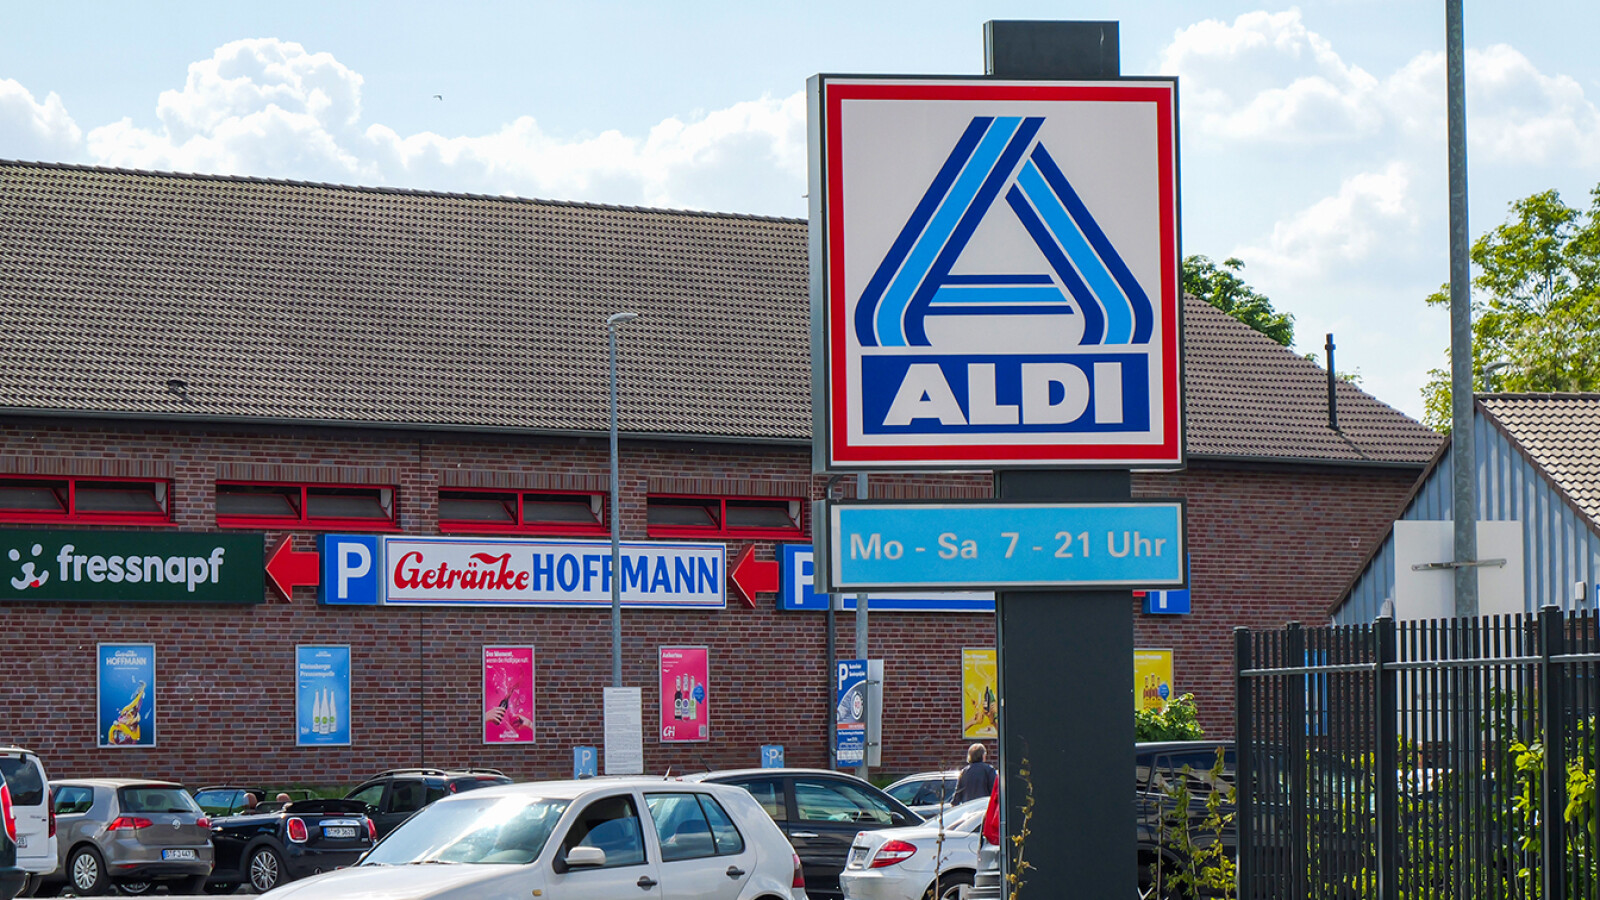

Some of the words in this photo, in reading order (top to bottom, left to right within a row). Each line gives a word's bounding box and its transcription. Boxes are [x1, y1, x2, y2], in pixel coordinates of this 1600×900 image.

[882, 362, 1124, 426] ALDI
[850, 533, 904, 560] Mo
[938, 532, 978, 559] Sa
[1001, 532, 1020, 558] 7
[1054, 531, 1090, 558] 21
[1107, 531, 1167, 557] Uhr
[57, 544, 225, 592] fressnapf
[337, 542, 372, 599] P
[393, 551, 530, 591] Getränke
[532, 553, 719, 594] HOFFMANN
[106, 656, 147, 666] HOFFMANN
[838, 663, 849, 690] P
[582, 750, 592, 767] P
[770, 749, 779, 765] P
